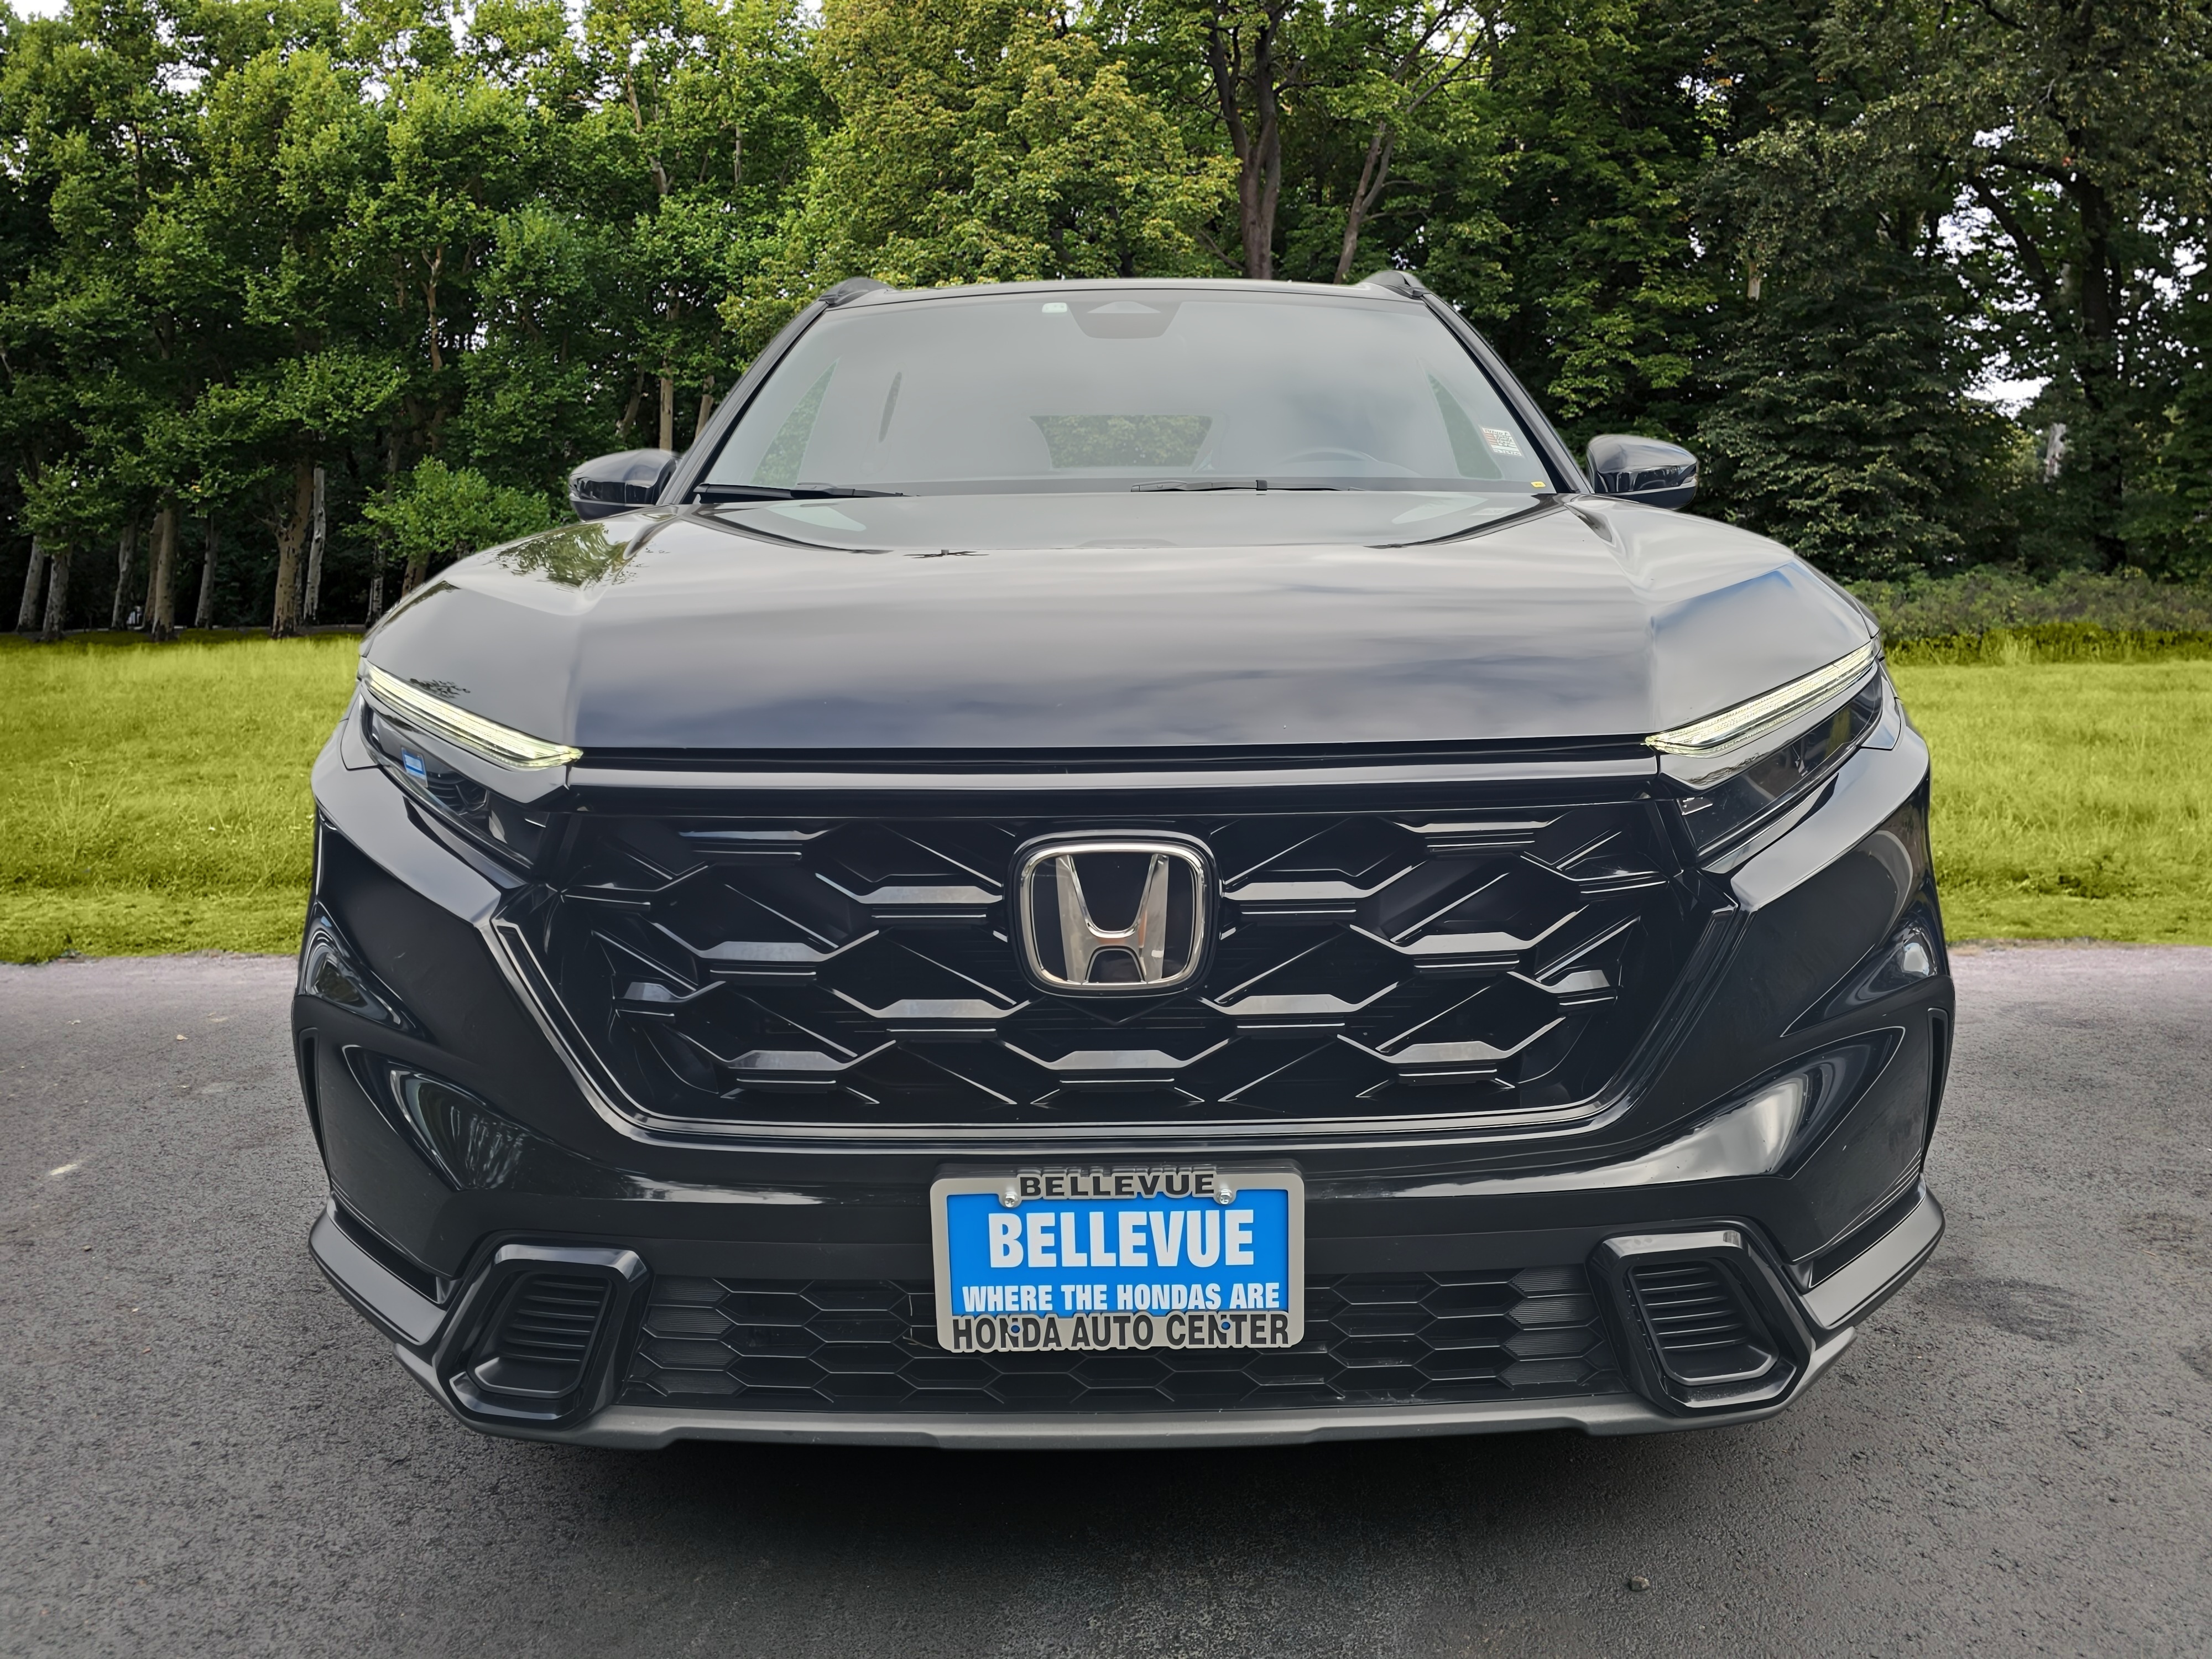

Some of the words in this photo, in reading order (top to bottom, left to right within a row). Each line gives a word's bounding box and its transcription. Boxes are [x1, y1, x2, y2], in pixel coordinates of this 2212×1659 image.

[1019, 1173, 1215, 1197] BELLEVUE
[988, 1209, 1254, 1267] BELLEVUE
[962, 1285, 1052, 1312] WHERE
[1061, 1285, 1107, 1310] THE
[1117, 1282, 1221, 1311] HONDAS
[1229, 1282, 1280, 1309] ARE
[953, 1316, 1062, 1349] HONDA
[1071, 1315, 1154, 1348] AUTO
[1166, 1313, 1288, 1345] CENTER
